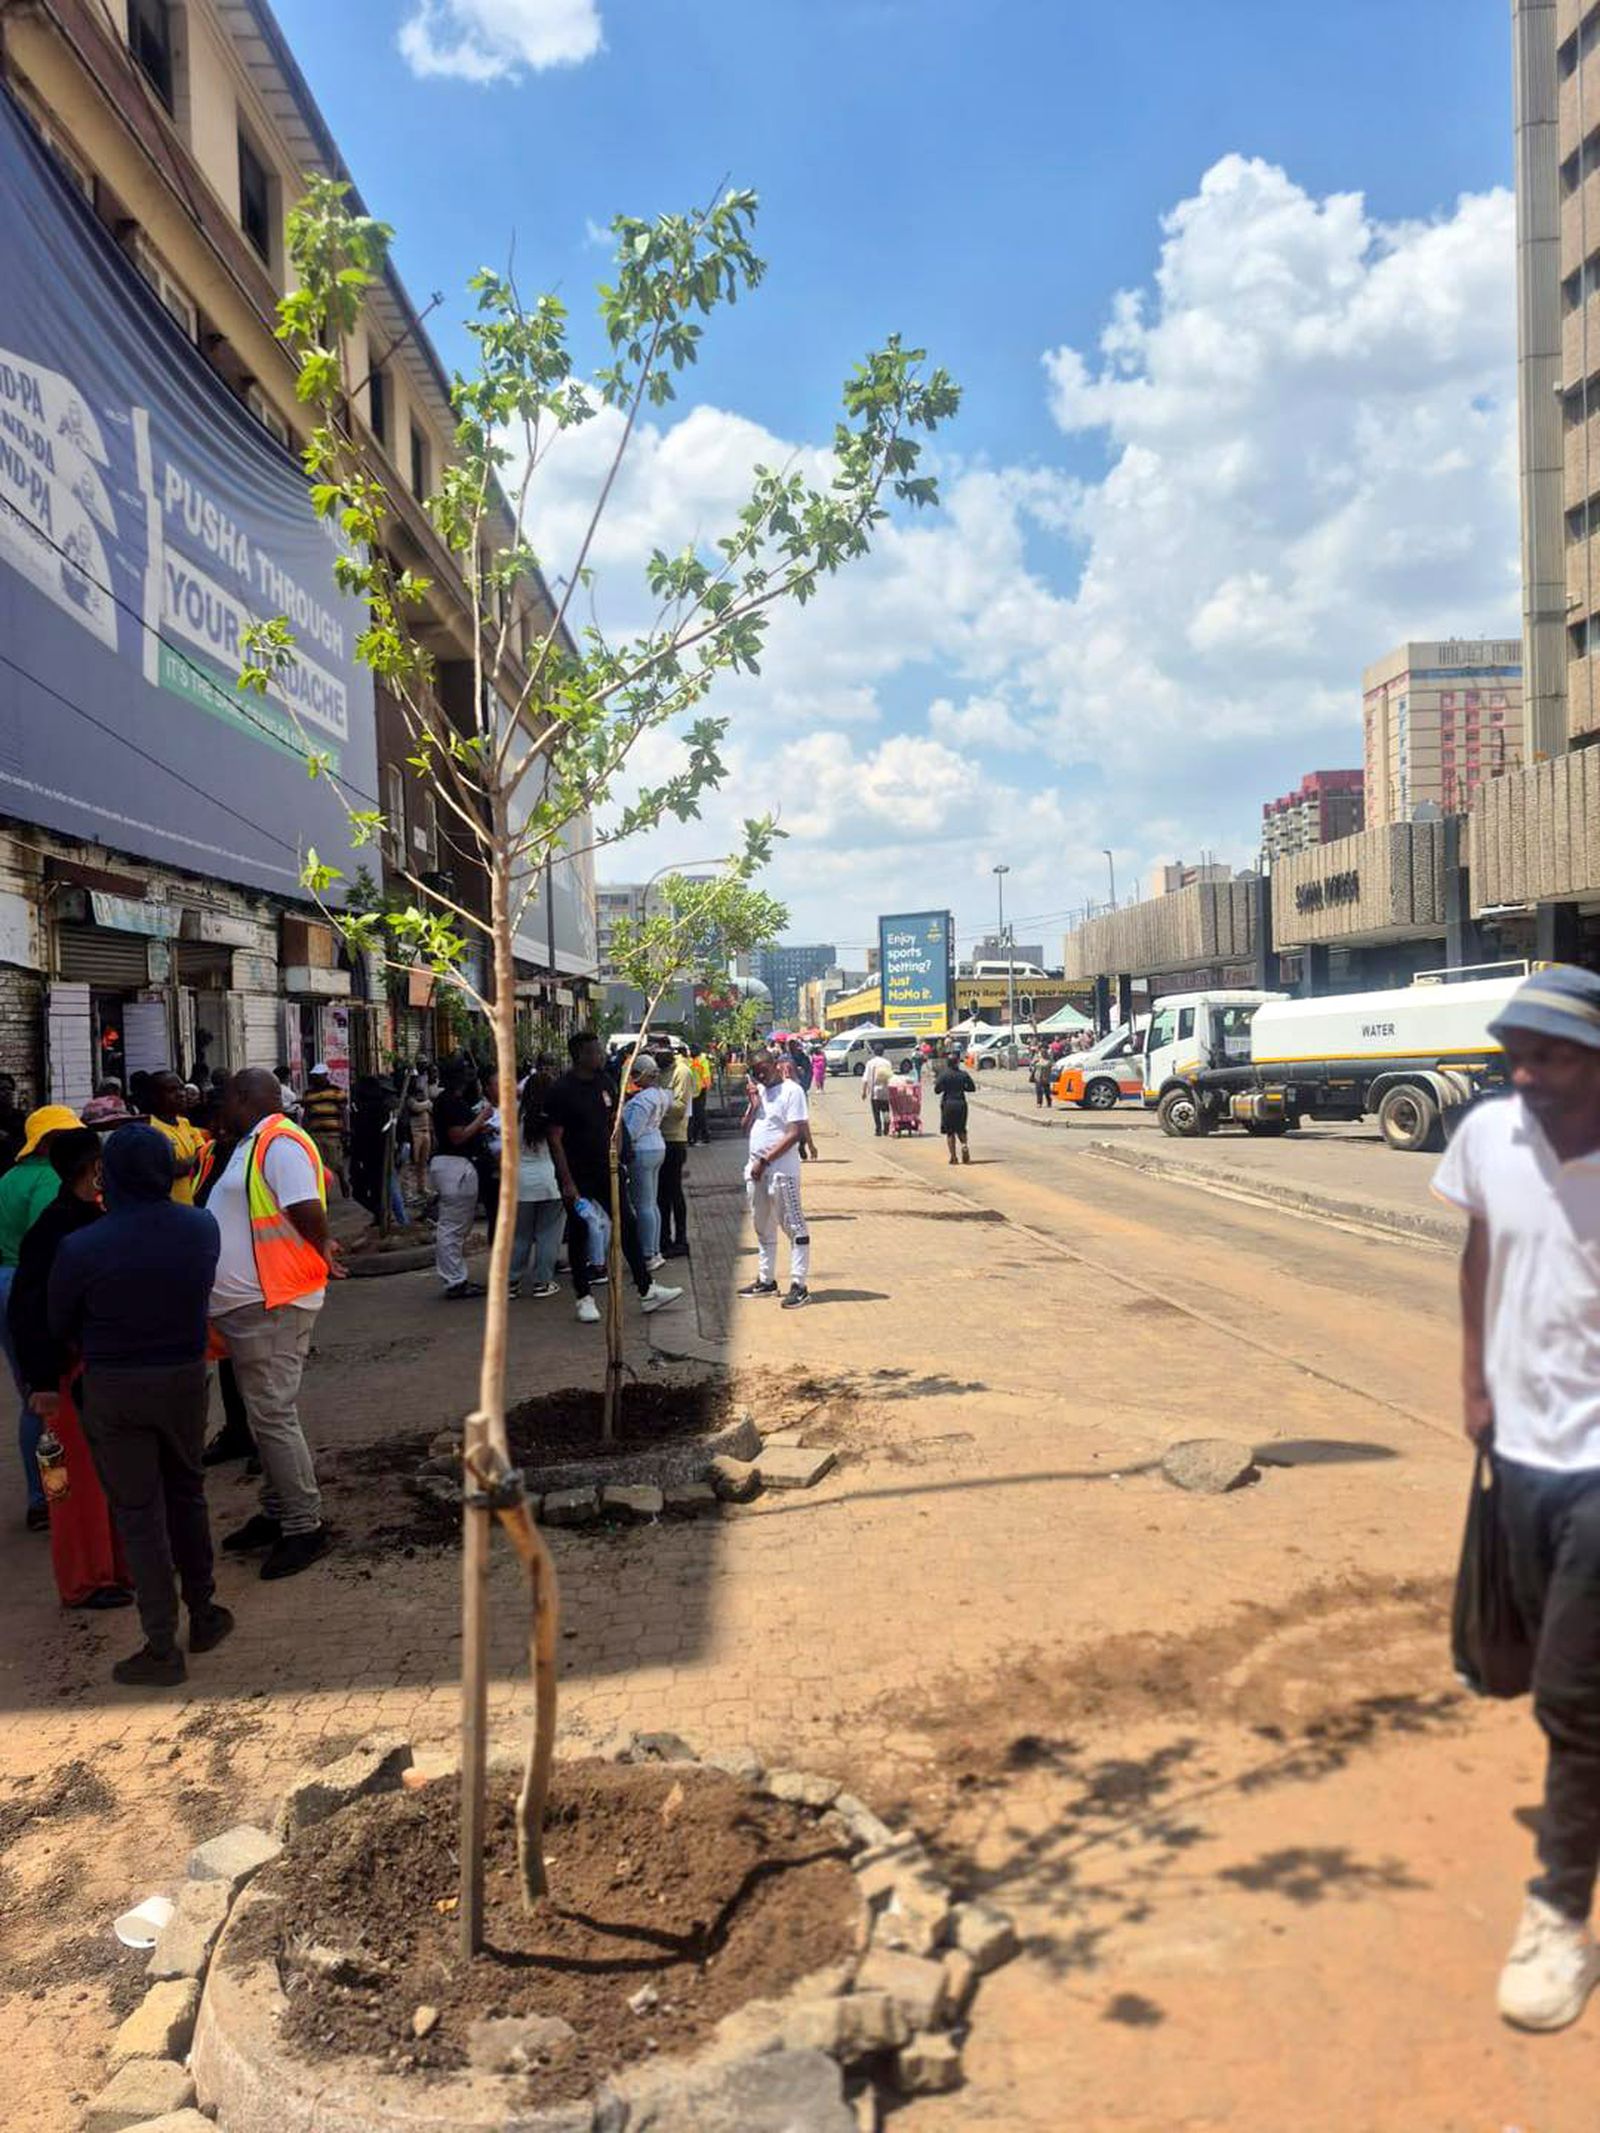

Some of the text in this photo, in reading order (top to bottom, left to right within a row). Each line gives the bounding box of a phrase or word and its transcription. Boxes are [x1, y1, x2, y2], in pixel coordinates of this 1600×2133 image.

[165, 461, 252, 582] PUSHA
[254, 548, 344, 661] THROUGH
[165, 562, 240, 658] YOUR
[887, 932, 917, 947] Enjoy
[887, 947, 922, 960] sports
[887, 959, 932, 973] betting?
[888, 976, 911, 987] Just
[959, 989, 980, 997] MTN
[1361, 1022, 1395, 1038] WATER
